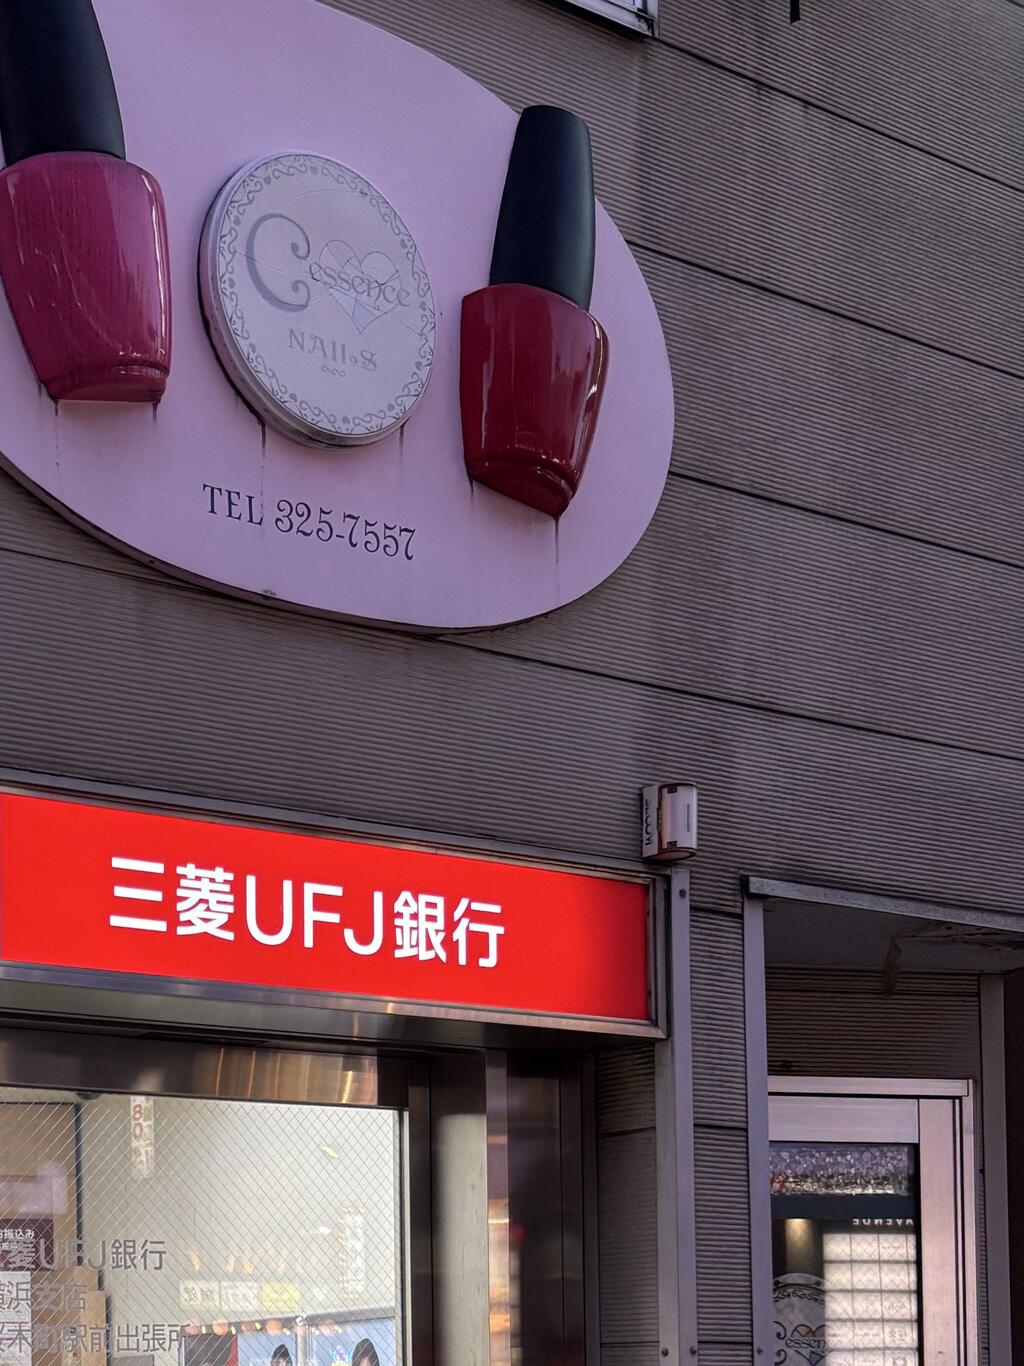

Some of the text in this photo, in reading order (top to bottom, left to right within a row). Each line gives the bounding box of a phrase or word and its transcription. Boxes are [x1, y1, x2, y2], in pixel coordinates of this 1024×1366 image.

[203, 484, 416, 560] TEL 325-7557
[110, 856, 506, 968] 三菱UFJ銀行
